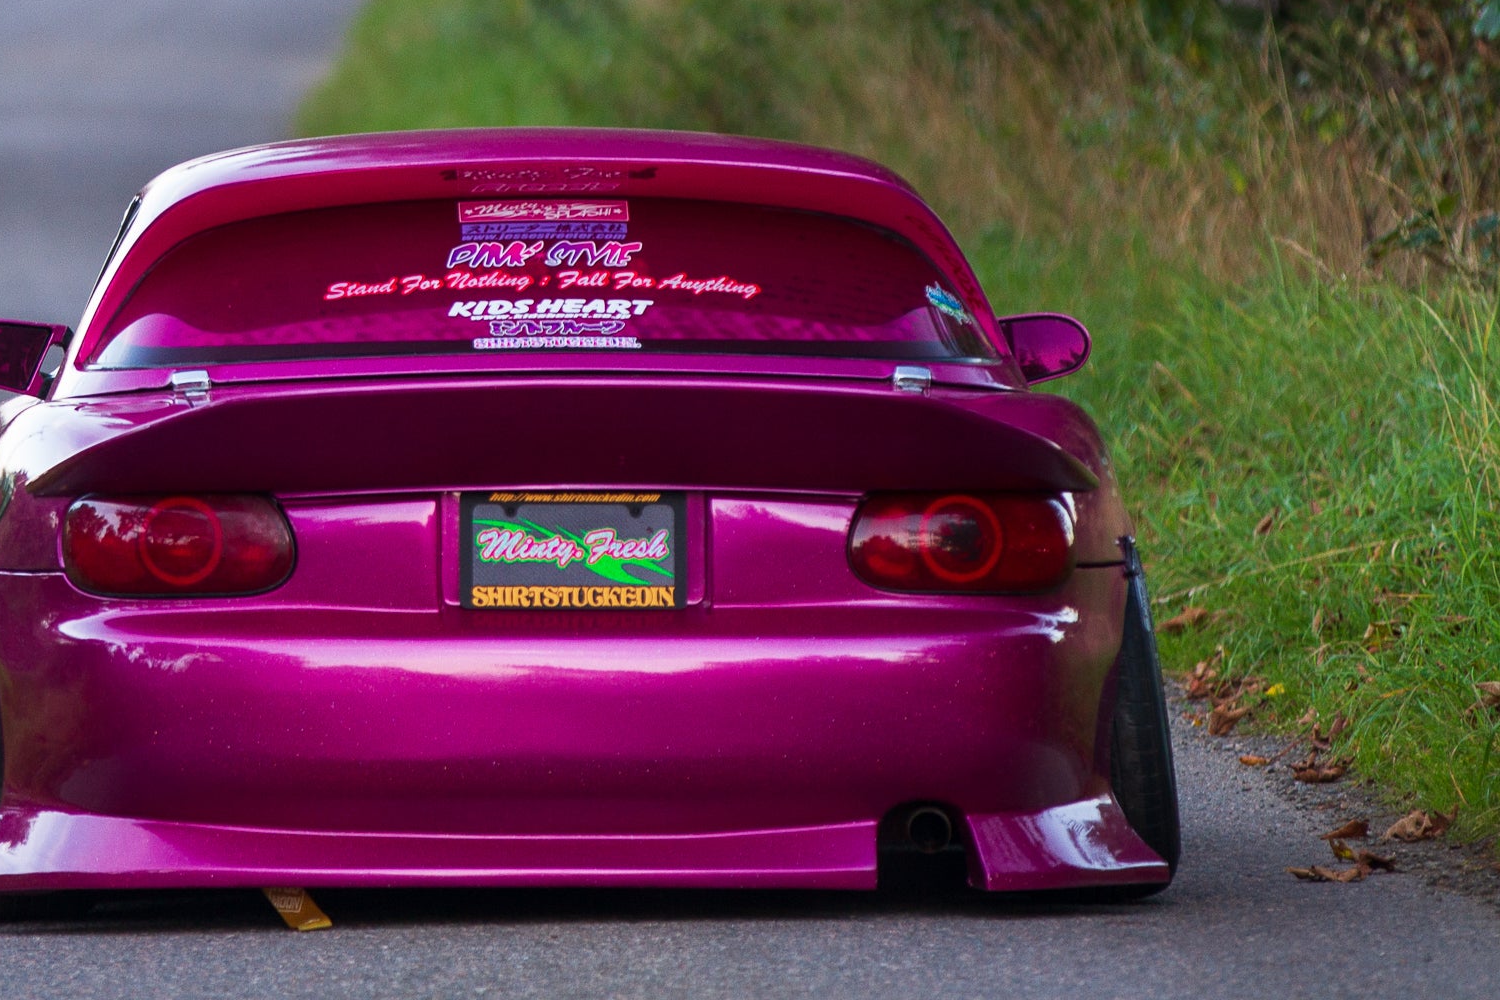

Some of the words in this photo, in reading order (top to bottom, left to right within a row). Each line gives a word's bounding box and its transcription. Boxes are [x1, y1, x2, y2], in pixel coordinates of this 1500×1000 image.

[325, 277, 397, 300] Stand
[400, 274, 443, 295] For
[447, 270, 534, 292] Nothing
[557, 270, 610, 290] Fall
[612, 271, 655, 291] For
[657, 271, 761, 299] Anything
[448, 299, 535, 318] KIDS
[536, 299, 654, 316] HEART
[488, 492, 661, 503] http://www.shirtstuckedin.com
[584, 528, 669, 566] Fresh
[472, 585, 676, 608] SHIRTSTUCKEDIN
